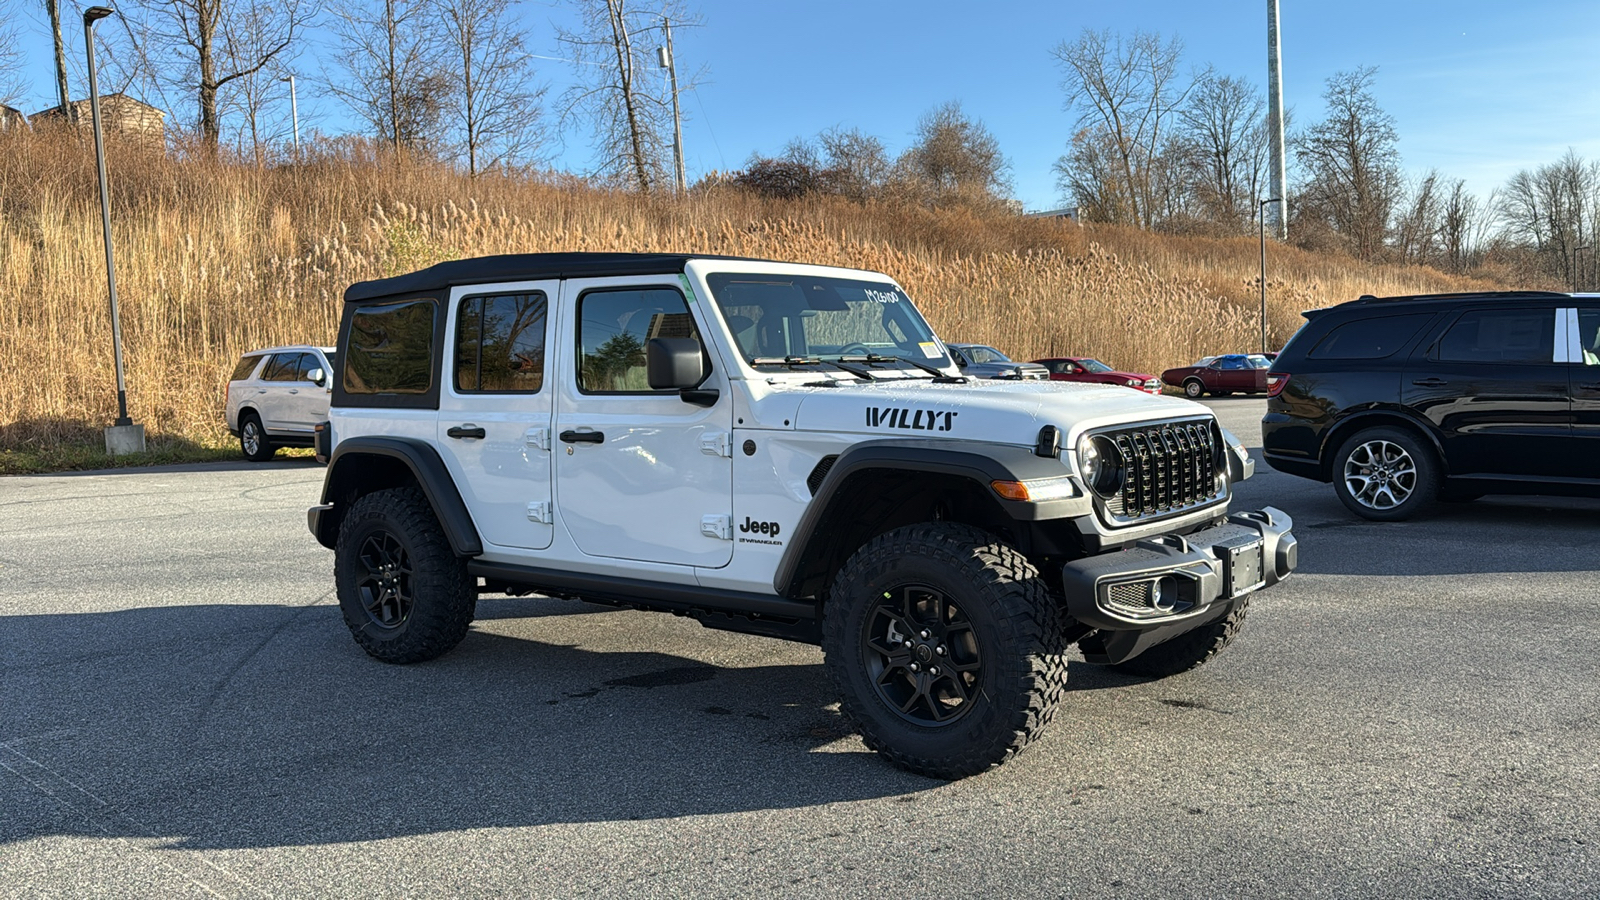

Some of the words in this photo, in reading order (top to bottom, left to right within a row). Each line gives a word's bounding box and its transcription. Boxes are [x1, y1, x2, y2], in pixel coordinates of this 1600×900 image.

[866, 407, 958, 431] WILLYS
[739, 516, 780, 538] Jeep
[745, 538, 783, 546] WRANGLER
